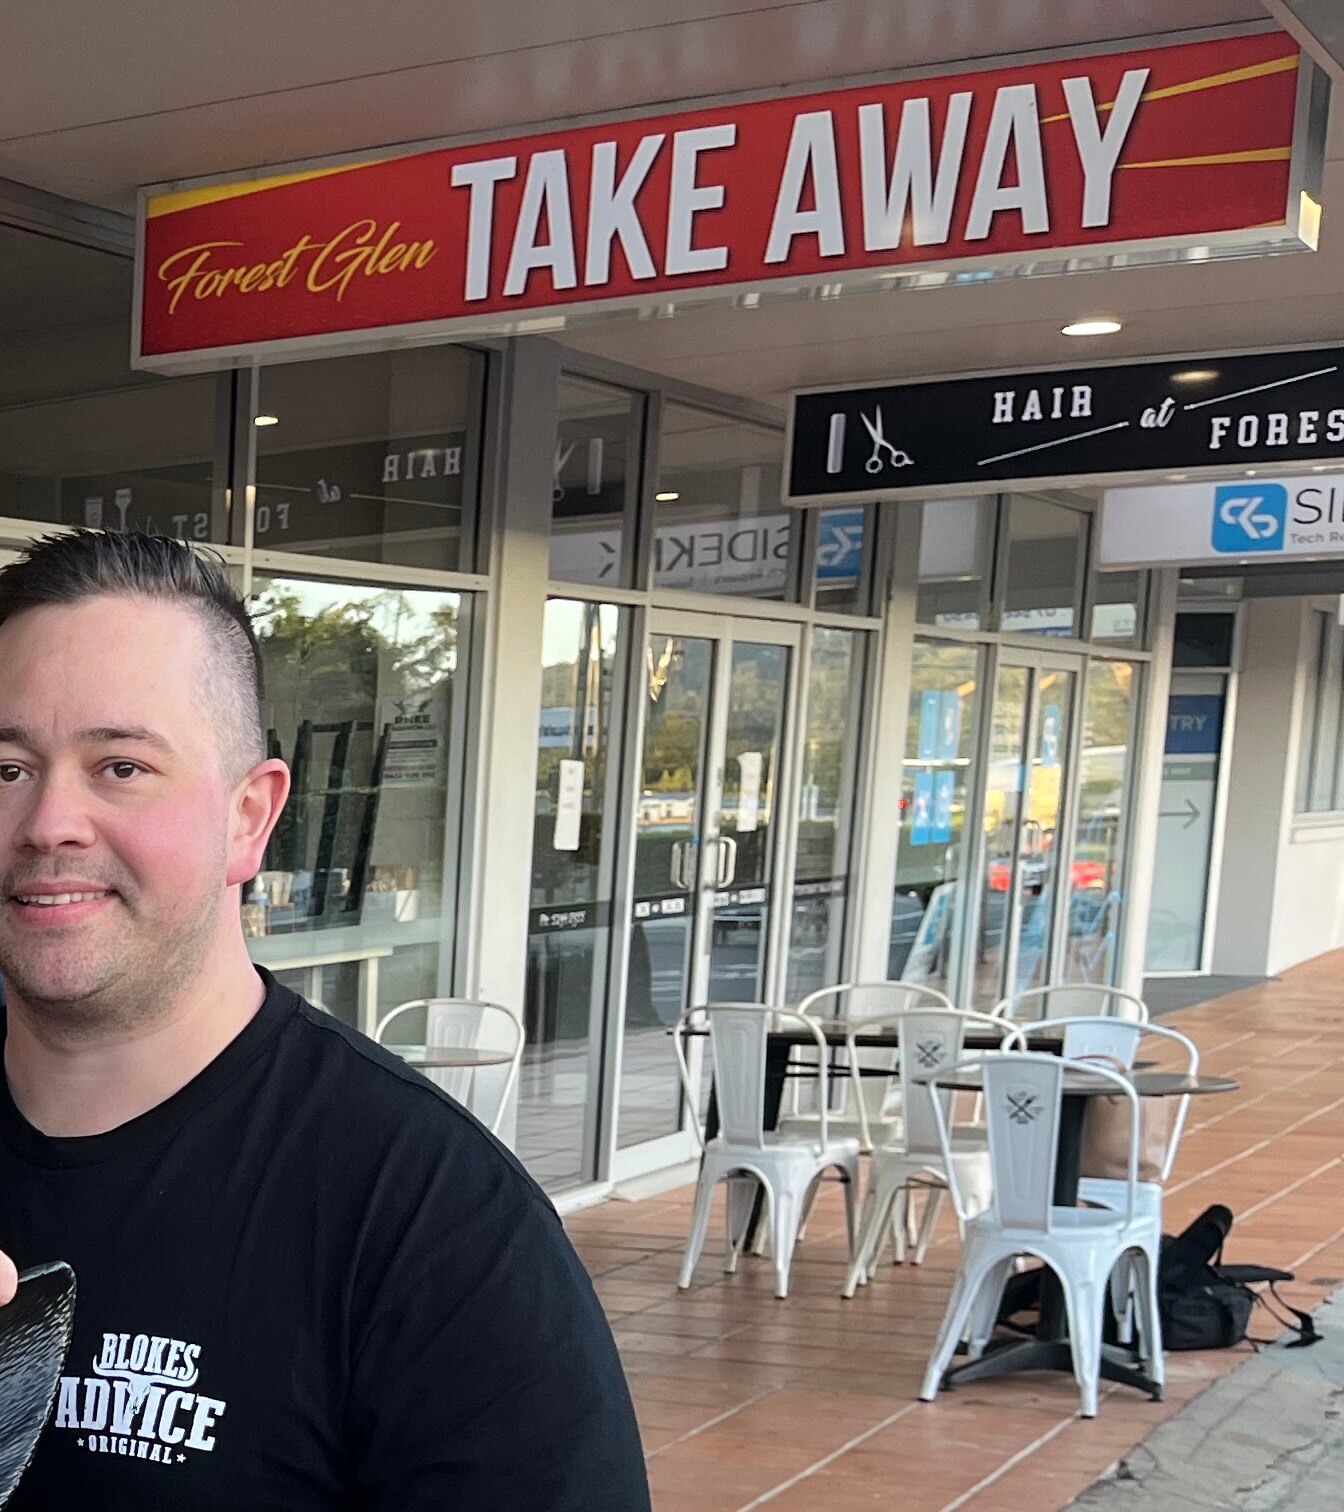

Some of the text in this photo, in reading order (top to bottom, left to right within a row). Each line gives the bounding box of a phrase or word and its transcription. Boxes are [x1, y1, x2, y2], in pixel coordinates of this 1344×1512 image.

[451, 68, 1151, 300] TAKE AWAY
[158, 219, 437, 314] Forest Glen
[991, 385, 1093, 423] HAIR
[1140, 397, 1176, 428] at
[1290, 532, 1324, 545] Tech
[98, 1333, 201, 1381] BLOKES
[55, 1377, 226, 1451] ADVICE
[88, 1434, 172, 1464] ORIGINAL
